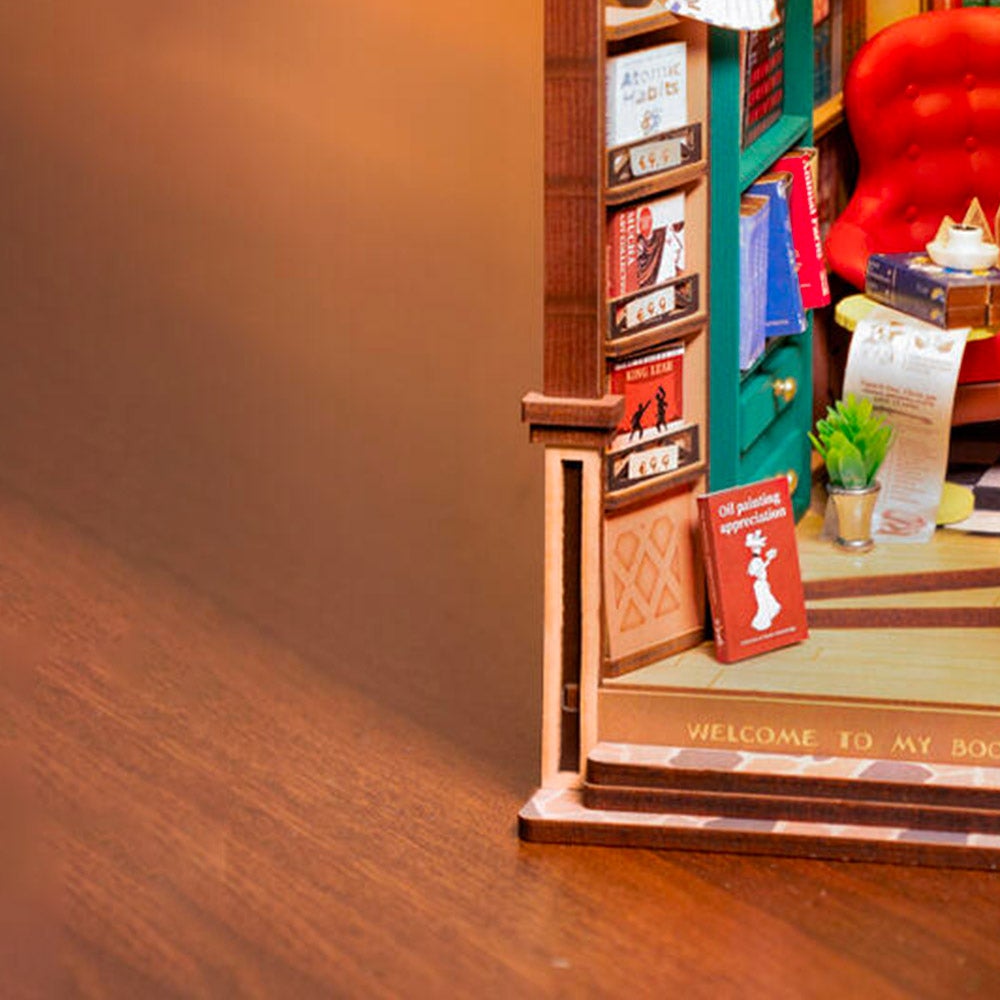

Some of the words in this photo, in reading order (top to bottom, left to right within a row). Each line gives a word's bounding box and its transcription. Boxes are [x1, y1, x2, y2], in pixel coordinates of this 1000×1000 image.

[718, 501, 735, 518] Oil
[736, 491, 781, 516] painting
[720, 505, 787, 535] appreciation
[685, 722, 818, 748] WELCOME
[838, 730, 873, 751] TO
[891, 734, 932, 755] MY
